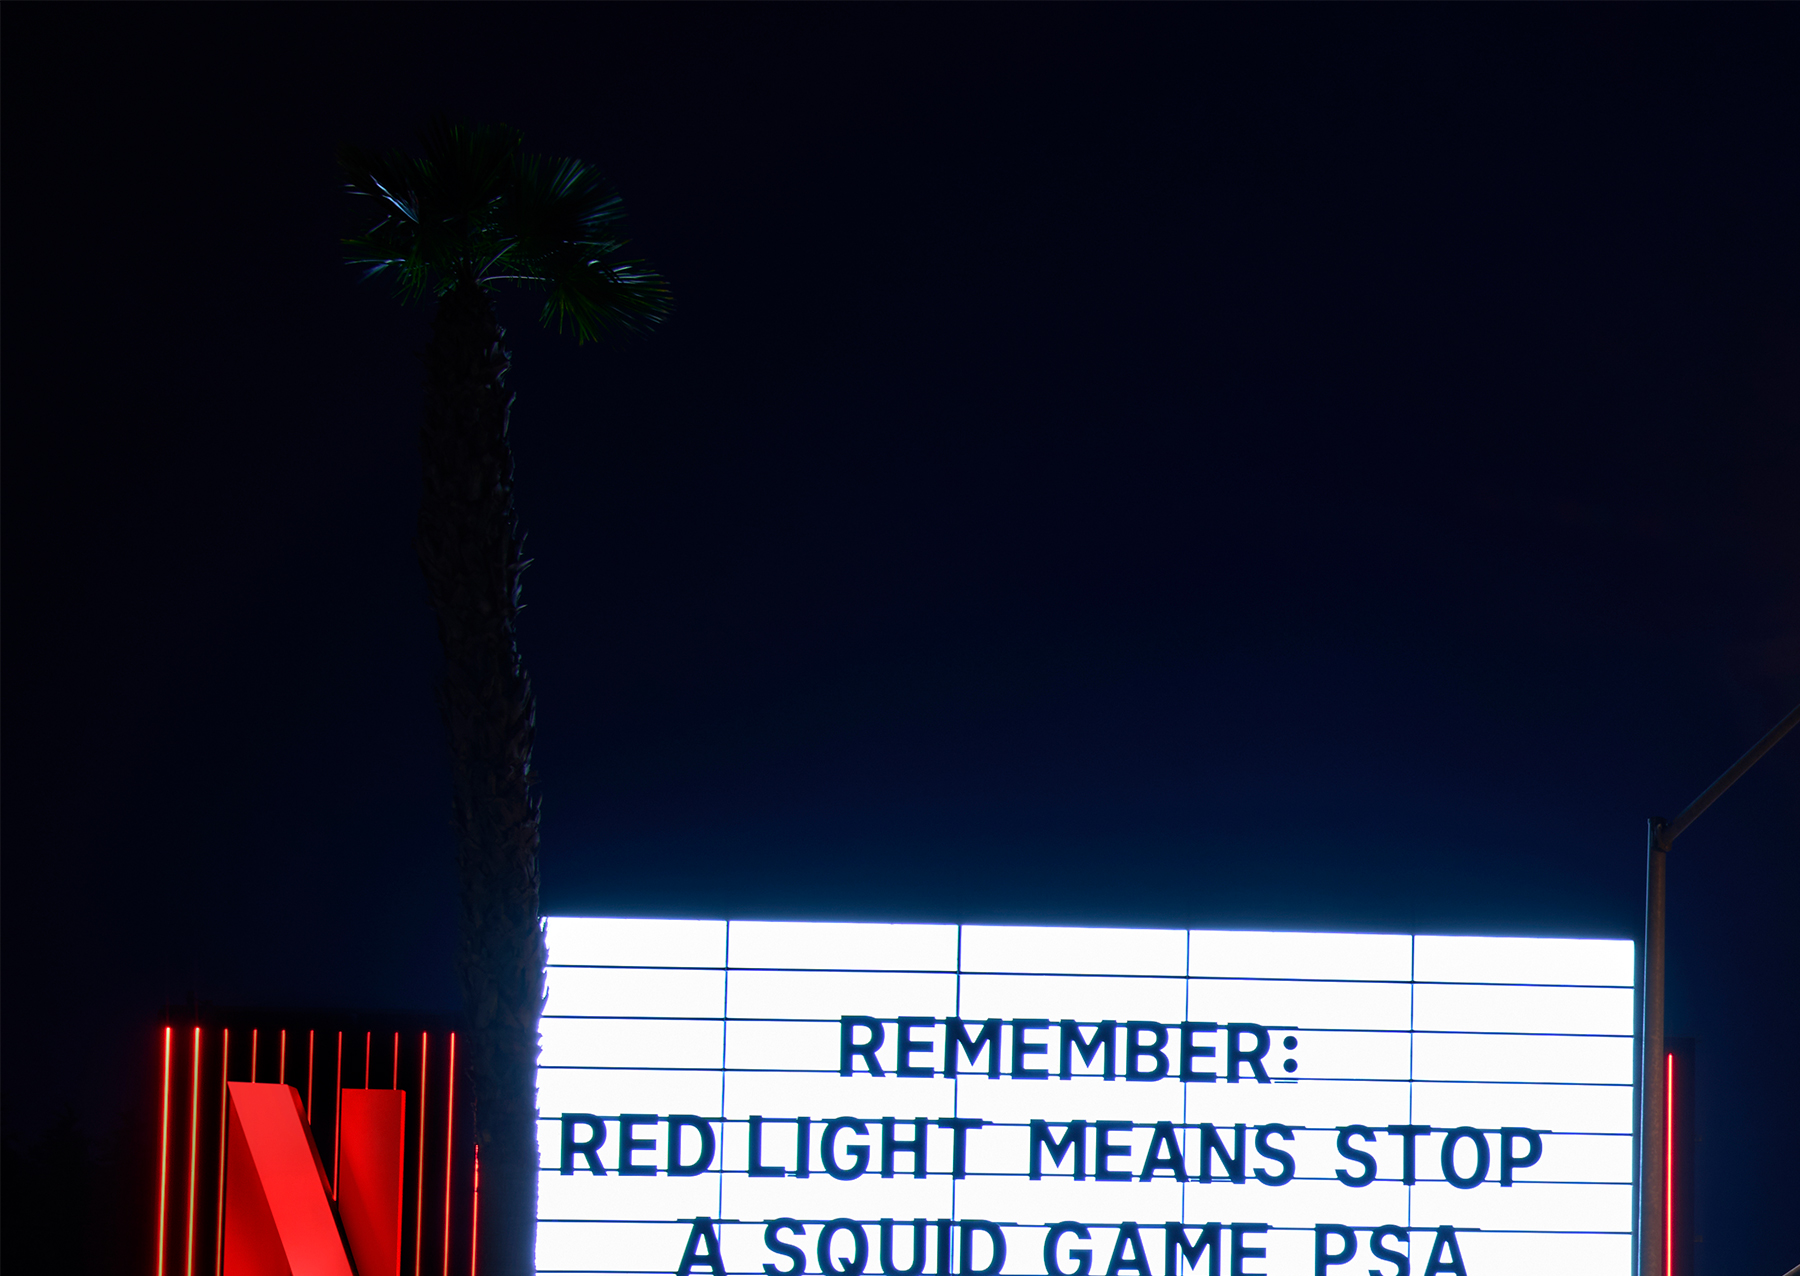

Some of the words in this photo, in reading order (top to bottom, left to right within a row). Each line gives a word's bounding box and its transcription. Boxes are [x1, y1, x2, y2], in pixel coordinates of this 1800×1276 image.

[839, 1015, 1299, 1084] REMEMBER:
[560, 1112, 716, 1176] RED
[748, 1114, 984, 1181] LIGHT
[1029, 1119, 1297, 1187] MEANS
[1334, 1123, 1543, 1190] STOP
